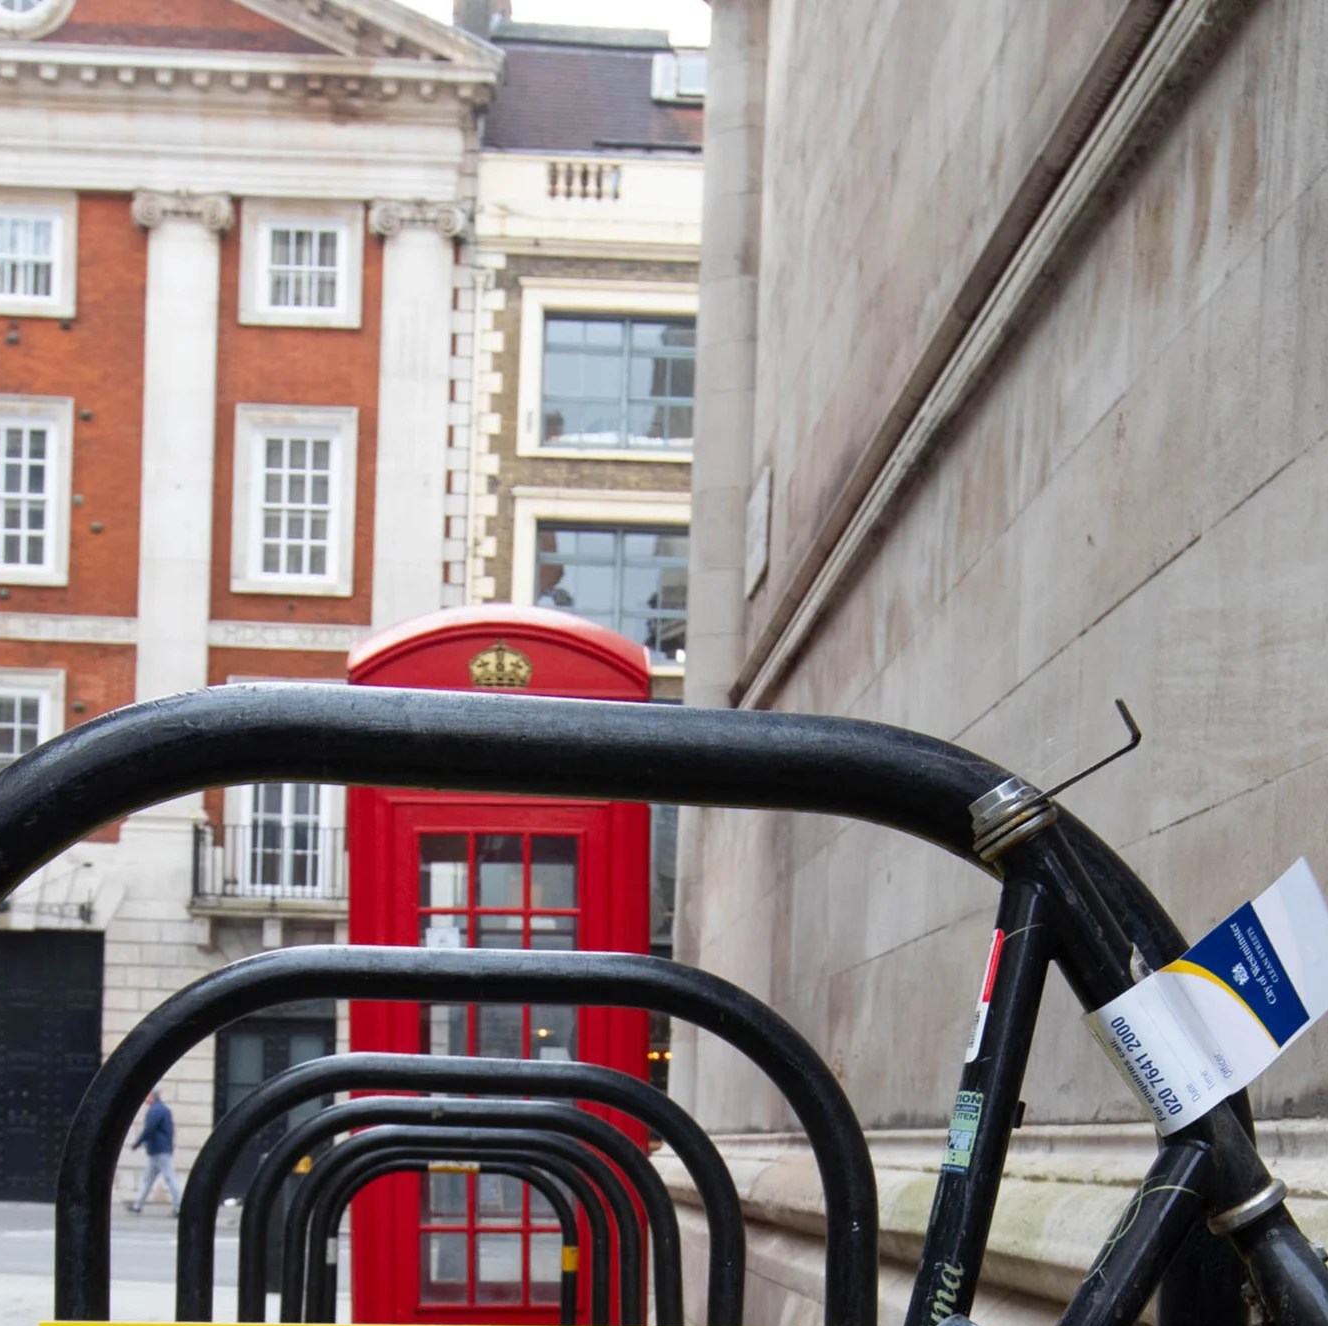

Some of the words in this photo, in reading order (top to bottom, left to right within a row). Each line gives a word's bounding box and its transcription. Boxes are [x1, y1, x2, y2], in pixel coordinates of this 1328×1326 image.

[1230, 922, 1261, 977] Westminster
[1255, 975, 1268, 986] of
[1263, 985, 1277, 1005] City
[1110, 1016, 1142, 1052] 2000
[1124, 1060, 1155, 1104] enquiries
[1135, 1053, 1165, 1088] 7641
[1153, 1106, 1167, 1122] For
[1158, 1087, 1183, 1115] 020
